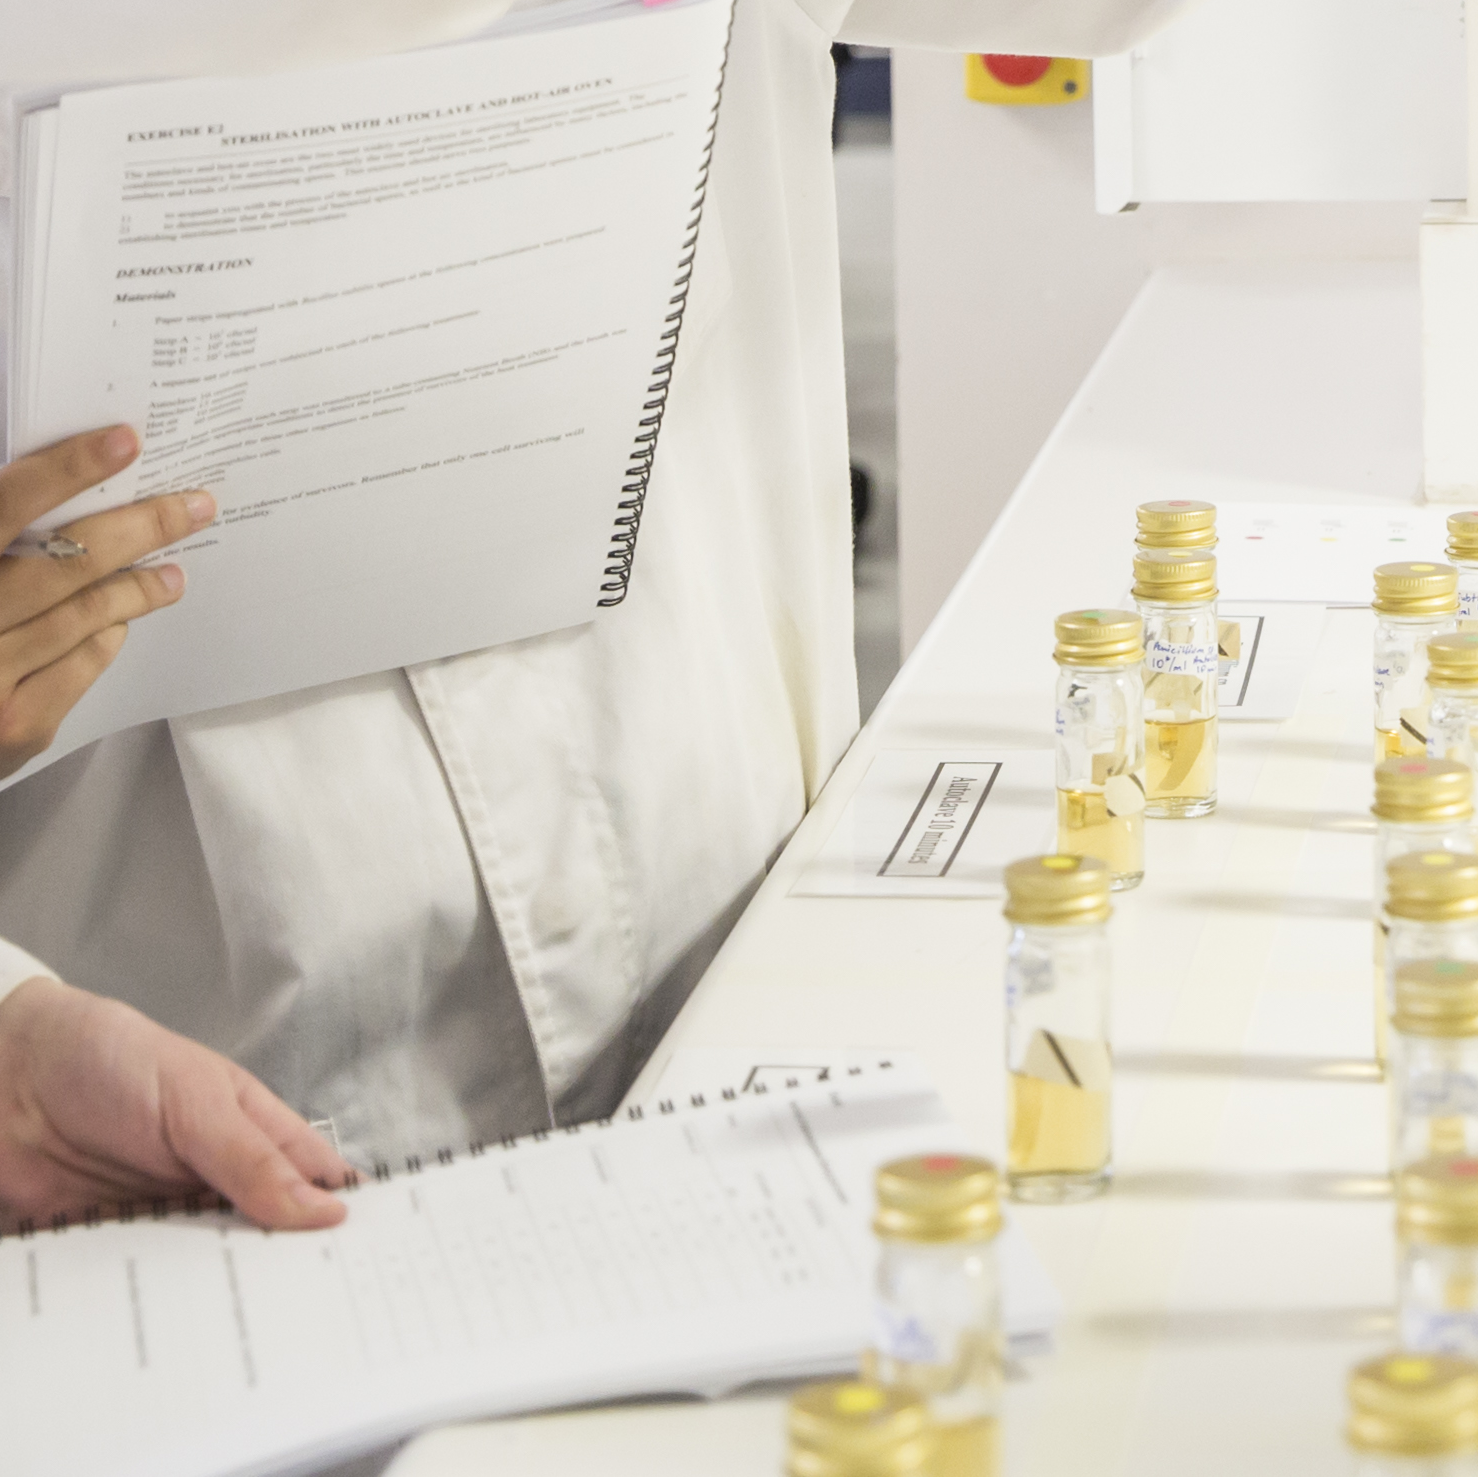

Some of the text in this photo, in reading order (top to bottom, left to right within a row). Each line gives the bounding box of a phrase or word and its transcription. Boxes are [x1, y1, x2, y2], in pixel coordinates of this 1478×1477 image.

[221, 125, 335, 145] STERILISATION
[340, 118, 381, 131] WITH
[385, 104, 474, 125] AUTOCLAVE
[480, 97, 507, 110] AND
[573, 77, 613, 91] OVEN
[127, 127, 202, 142] EXERCISE
[116, 259, 253, 278] DEMONSTRATION
[114, 291, 176, 303] Materials
[907, 776, 978, 864] Autoclave 10 minutes
